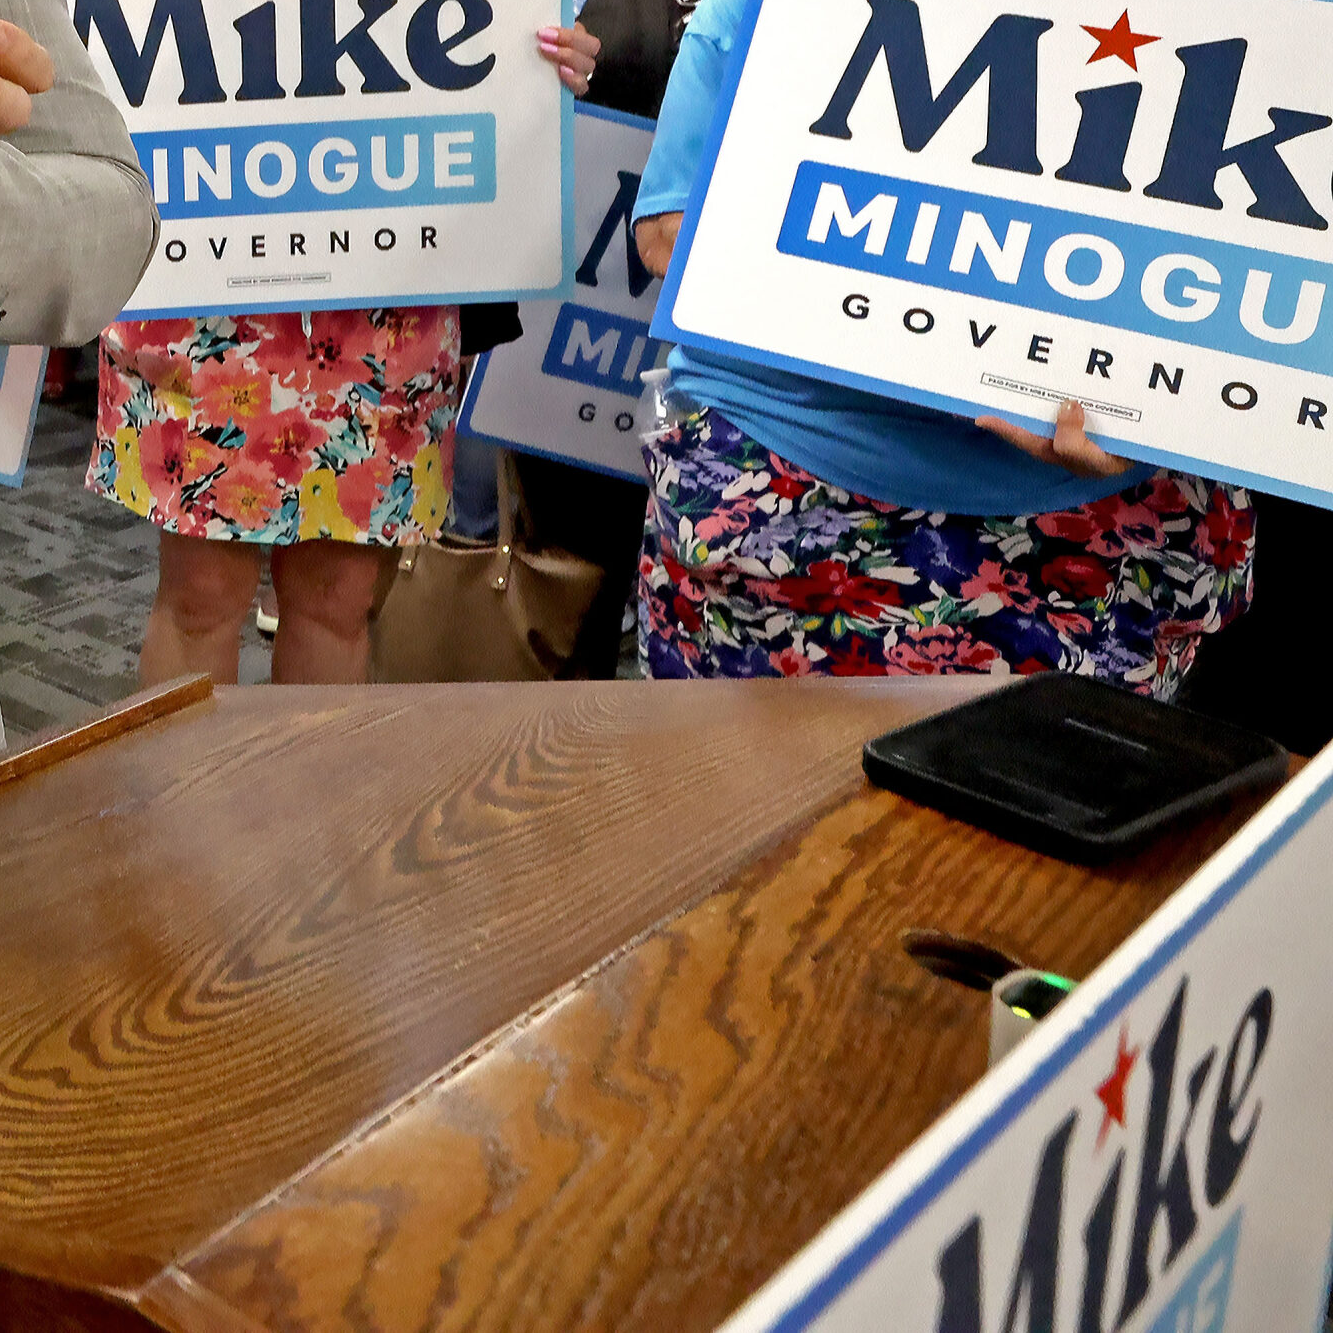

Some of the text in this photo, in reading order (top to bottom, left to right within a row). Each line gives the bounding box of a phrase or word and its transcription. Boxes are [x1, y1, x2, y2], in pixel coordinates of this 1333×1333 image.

[153, 130, 476, 204] INOGUE
[165, 225, 438, 263] OVERNOR
[805, 182, 1330, 346] MINOGU
[842, 294, 1326, 430] GOVERNOR
